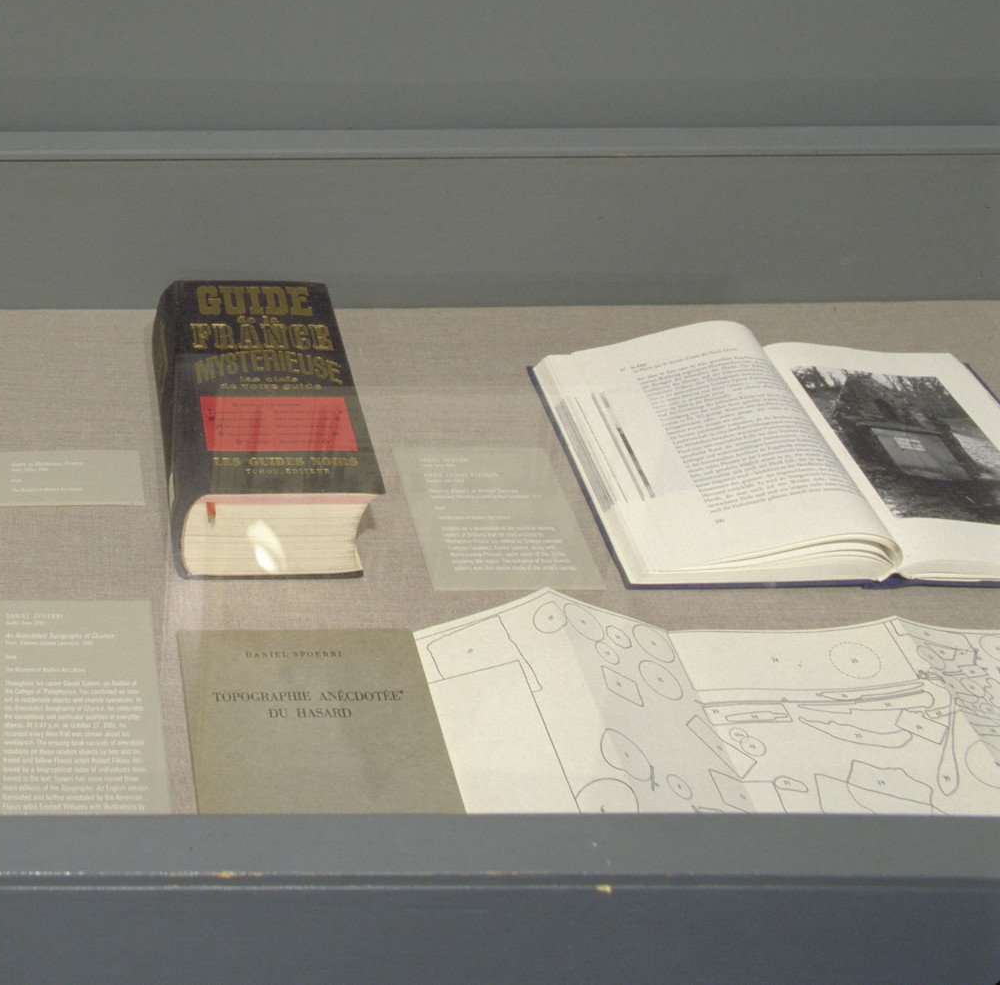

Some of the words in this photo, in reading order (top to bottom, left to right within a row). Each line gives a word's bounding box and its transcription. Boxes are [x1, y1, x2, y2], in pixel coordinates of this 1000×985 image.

[196, 285, 313, 316] GUIDE
[236, 315, 257, 324] de
[262, 315, 280, 324] la
[189, 323, 334, 351] FRANCE
[194, 349, 343, 385] MYSTERIEUSE
[213, 457, 242, 466] LES
[248, 457, 305, 466] GUIDES
[310, 457, 359, 466] NOIRS
[293, 650, 343, 658] SPOERRI
[212, 691, 312, 702] TOPOGRAPHIE
[268, 708, 288, 719] DU
[296, 707, 352, 719] HASARD
